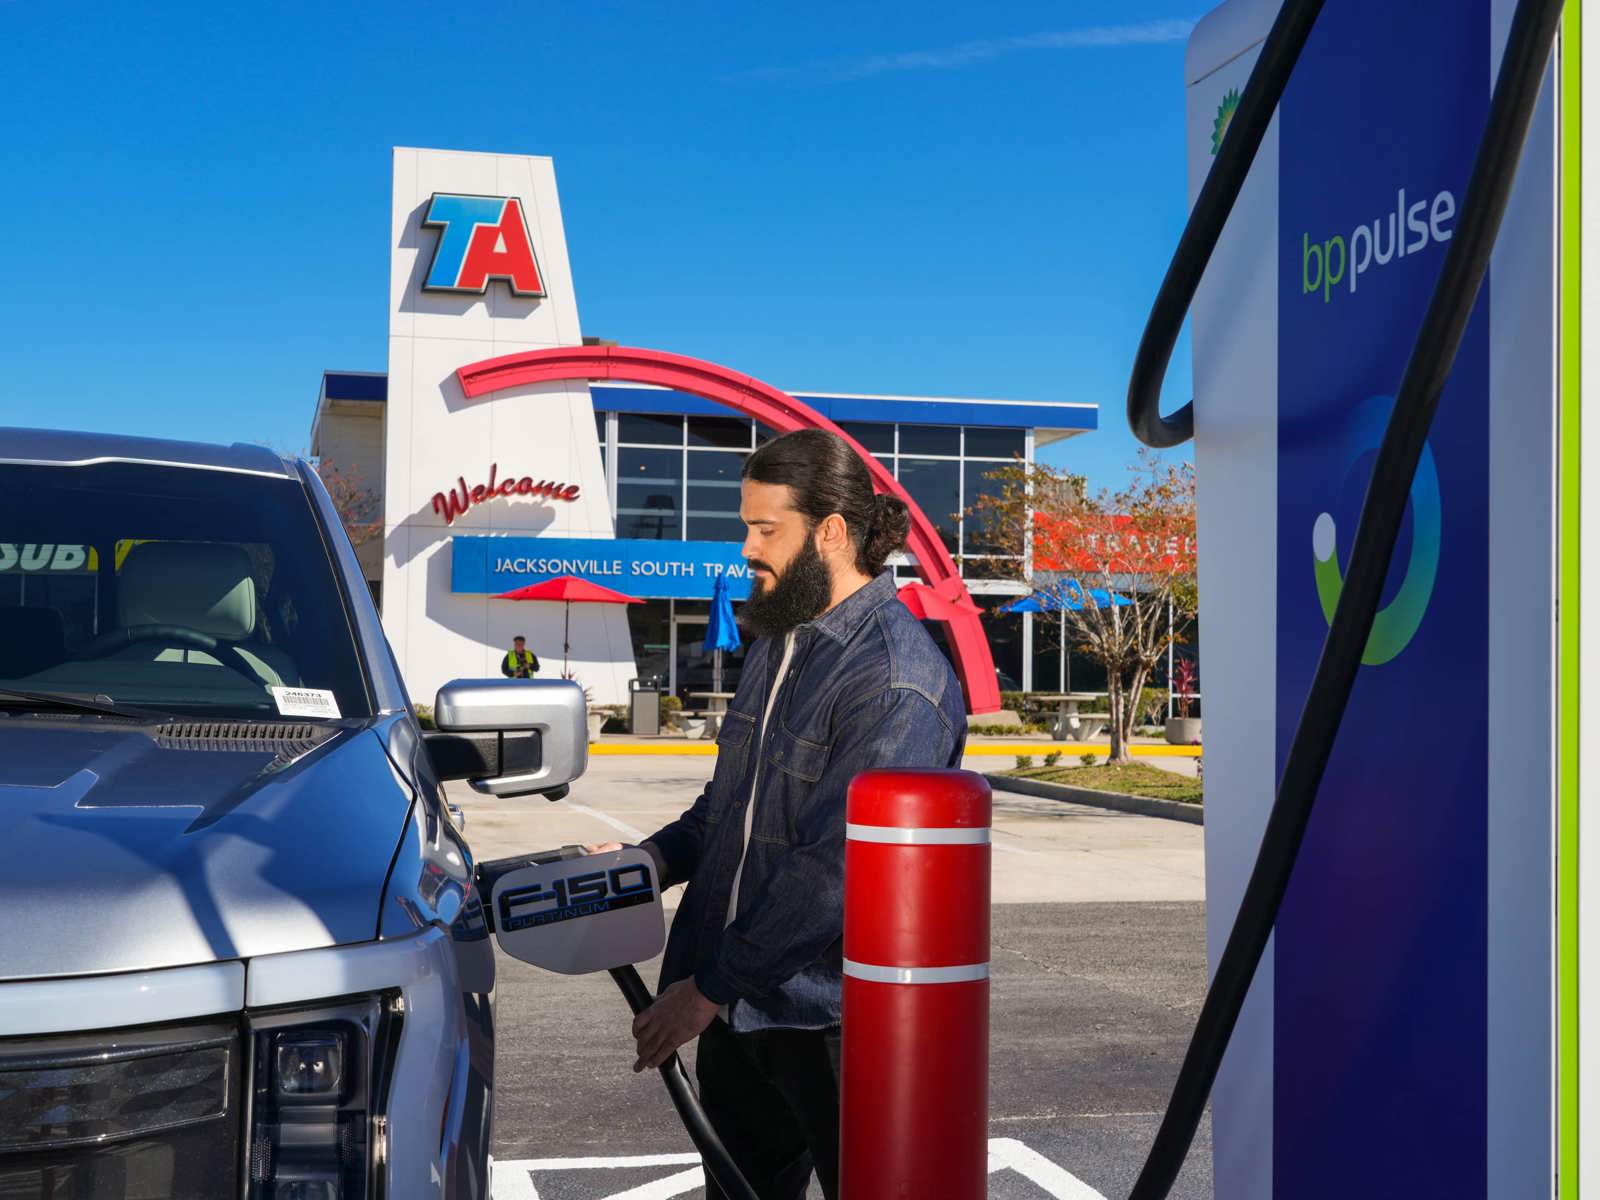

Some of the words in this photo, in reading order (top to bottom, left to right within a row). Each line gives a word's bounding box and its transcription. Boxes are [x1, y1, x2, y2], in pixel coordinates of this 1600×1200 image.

[421, 192, 548, 298] TA
[1350, 188, 1456, 293] pulse
[432, 463, 581, 525] Welcome
[0, 543, 98, 571] SUB
[495, 557, 622, 576] JACKSONVILLE
[631, 560, 694, 577] SOUTH
